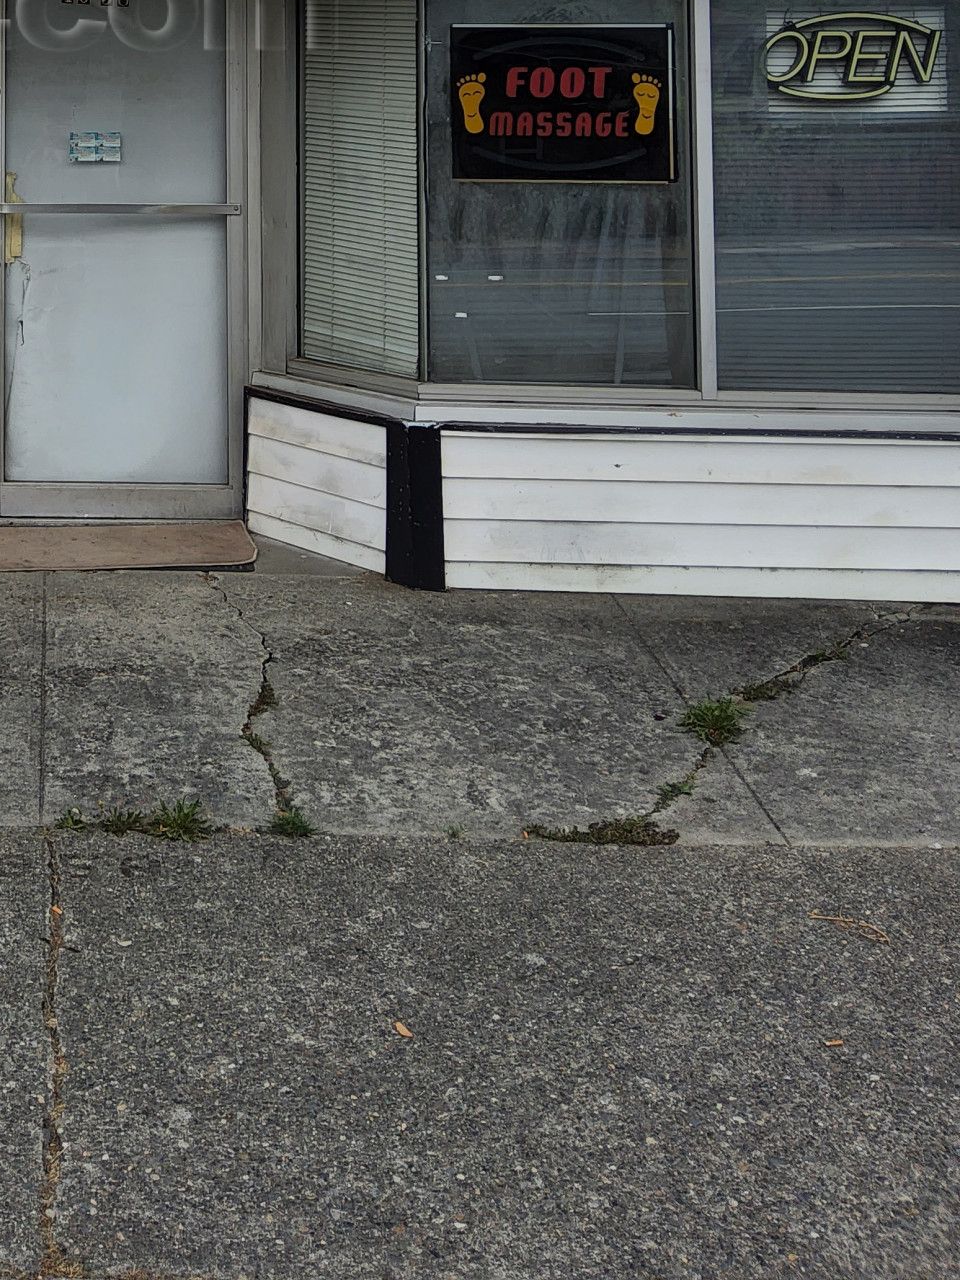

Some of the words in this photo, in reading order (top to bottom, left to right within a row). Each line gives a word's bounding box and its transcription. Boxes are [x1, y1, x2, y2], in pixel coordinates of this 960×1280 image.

[761, 30, 942, 82] OPEN
[505, 66, 613, 99] FOOT
[490, 111, 631, 137] MASSAGE
